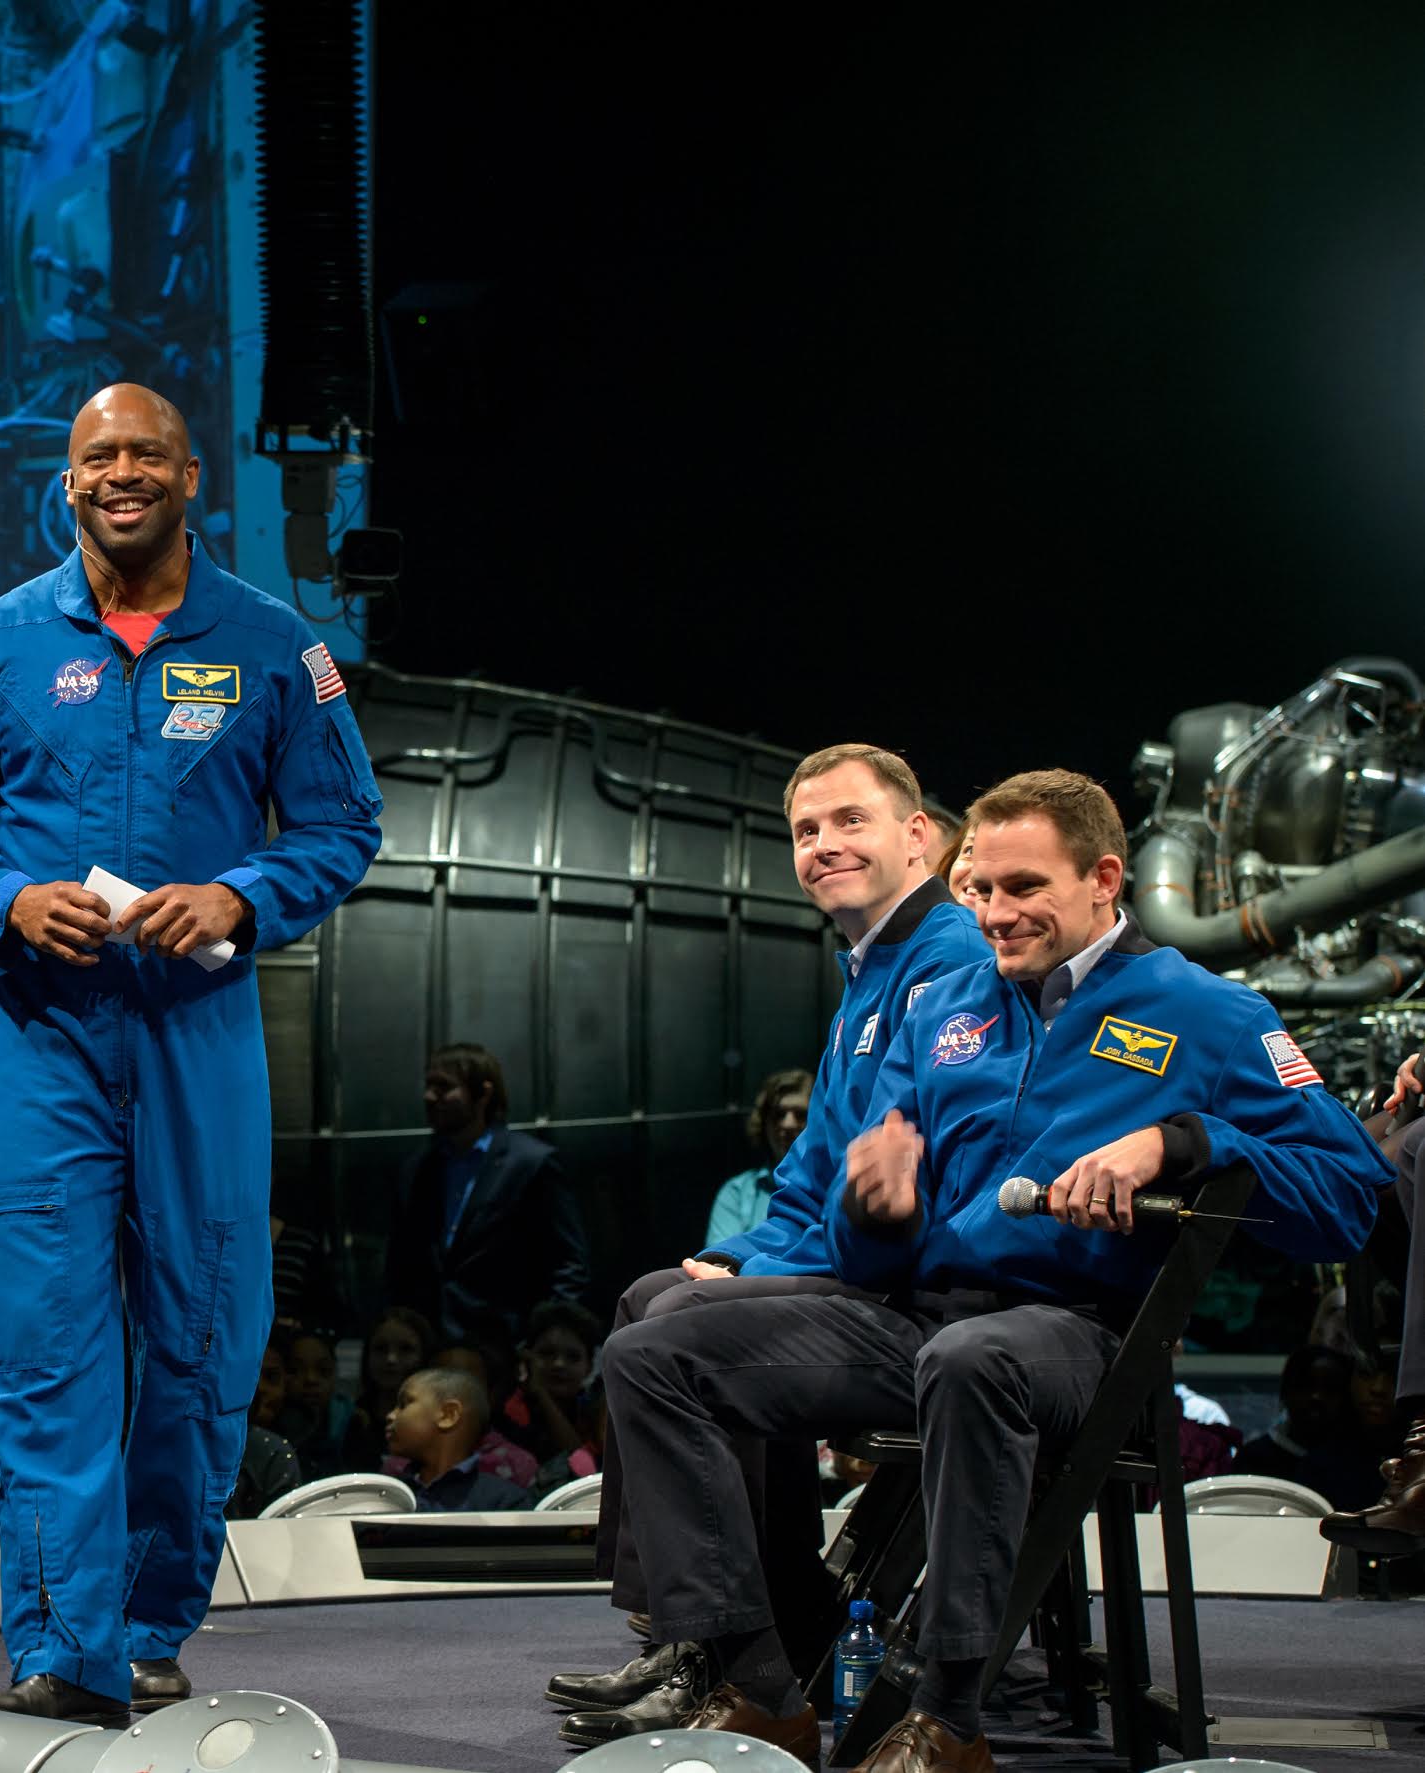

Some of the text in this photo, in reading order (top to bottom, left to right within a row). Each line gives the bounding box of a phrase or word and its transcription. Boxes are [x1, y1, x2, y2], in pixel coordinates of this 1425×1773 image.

[56, 674, 99, 689] NASA
[203, 690, 225, 698] MELVIN
[938, 1032, 982, 1047] NASA
[1103, 1046, 1154, 1067] JOSH CASSADA
